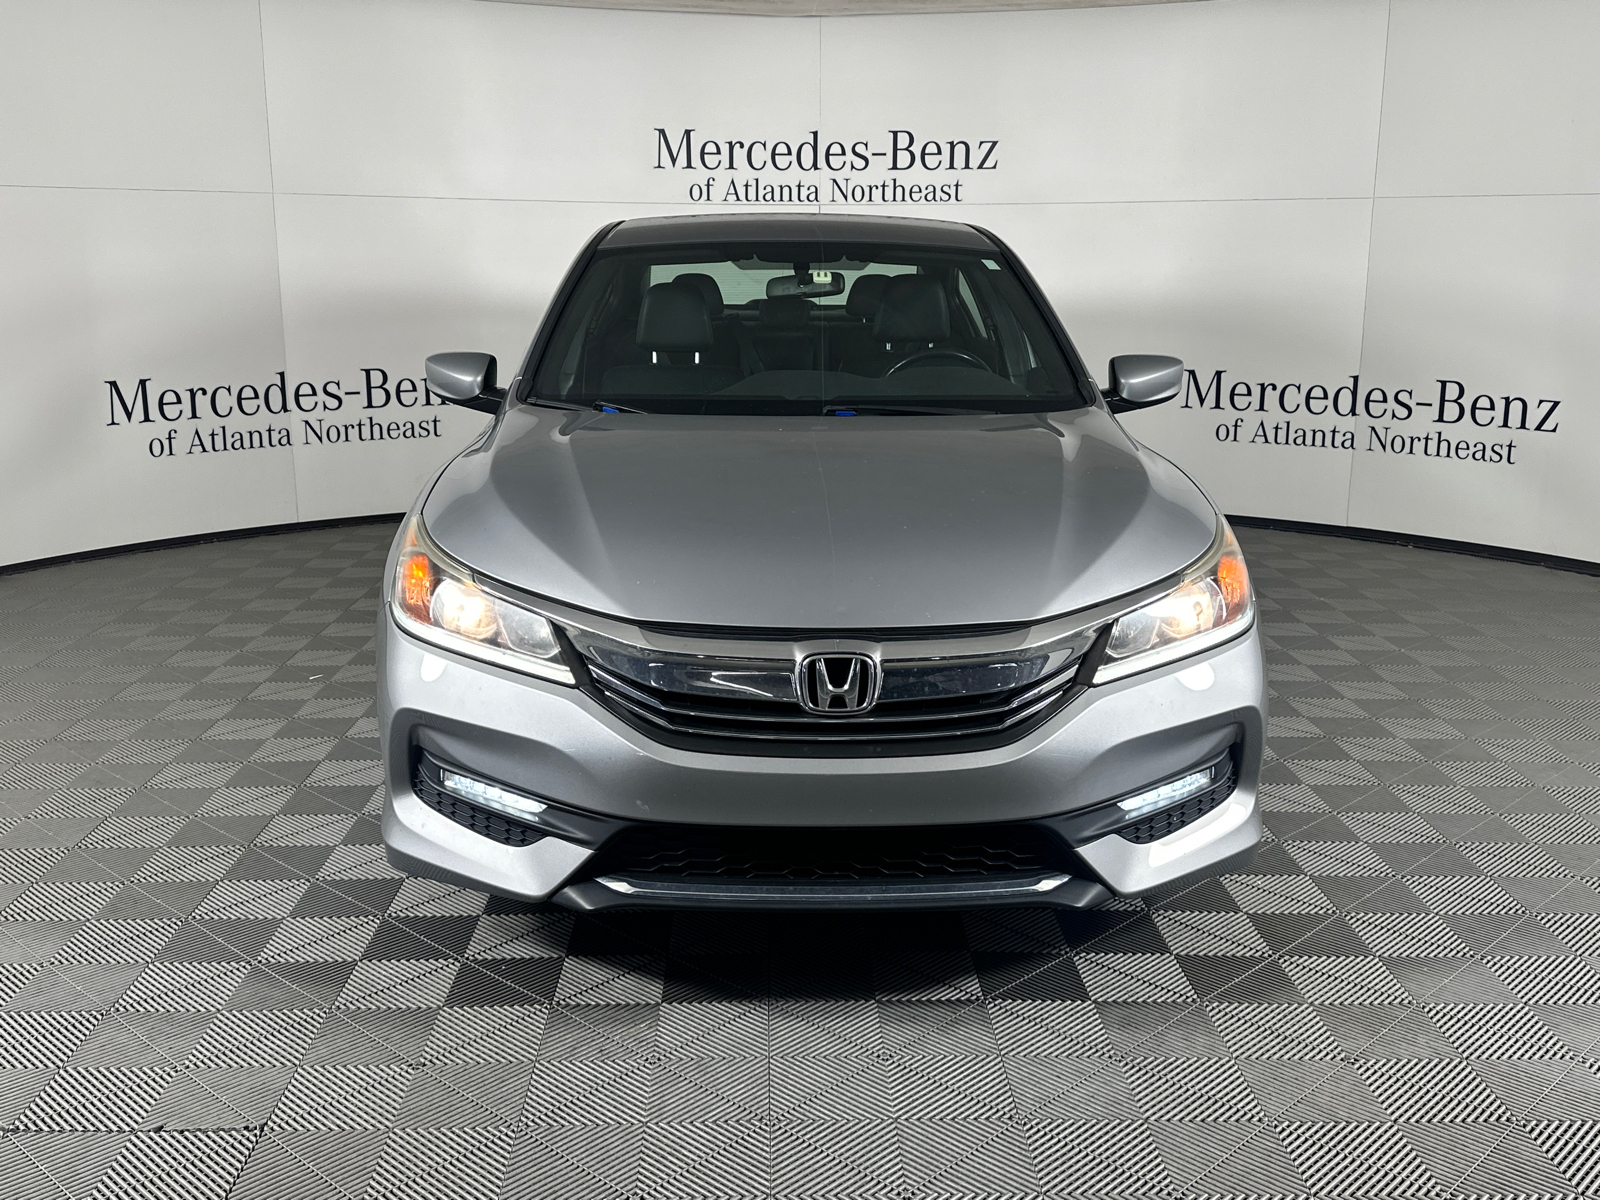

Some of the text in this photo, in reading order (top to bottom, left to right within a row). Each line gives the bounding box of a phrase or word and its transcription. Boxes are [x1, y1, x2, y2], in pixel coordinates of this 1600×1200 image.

[654, 128, 999, 171] Mercedes-Benz
[689, 178, 963, 202] of Atlanta Northeast
[105, 368, 452, 427] Mercedes-Be
[1181, 369, 1562, 433] Mercedes-Benz
[149, 415, 442, 458] of Atlanta Northeast
[1215, 418, 1516, 465] of Atlanta Northeast
